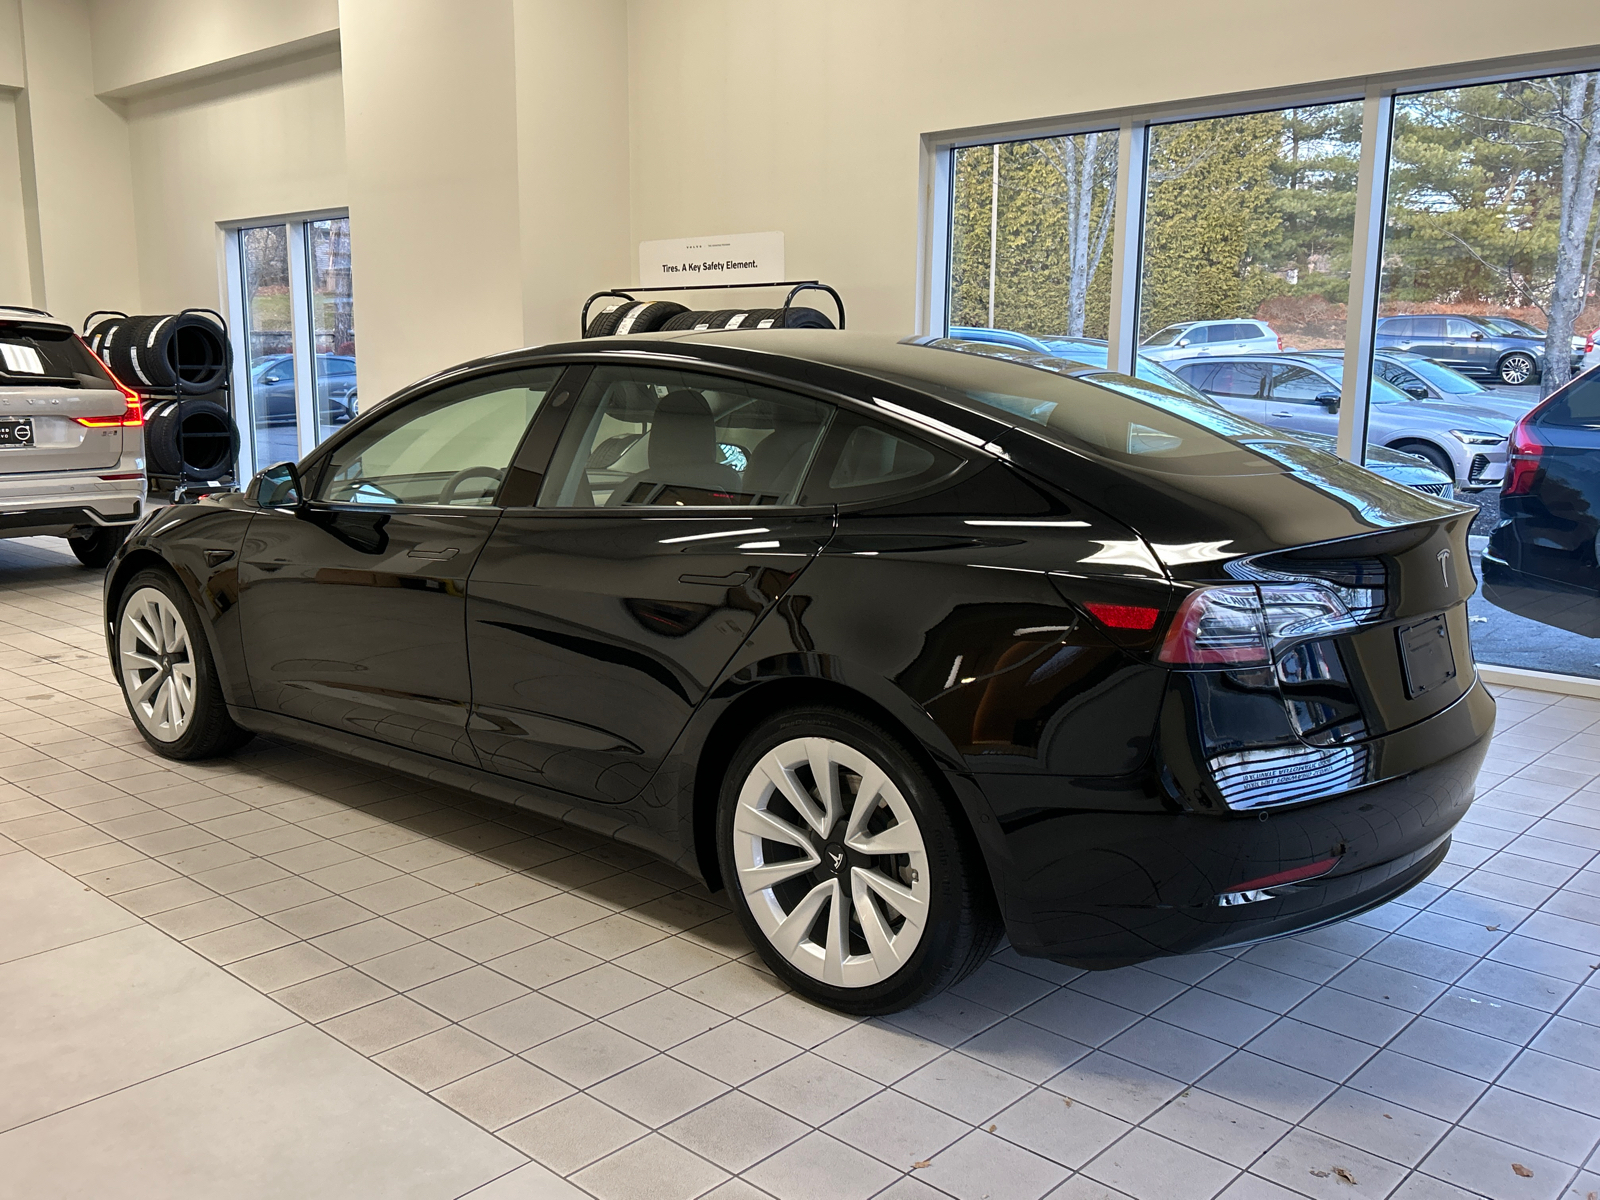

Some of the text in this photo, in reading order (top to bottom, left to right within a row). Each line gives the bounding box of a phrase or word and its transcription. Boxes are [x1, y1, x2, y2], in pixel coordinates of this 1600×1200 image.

[662, 259, 758, 273] Tires. A Key Safety Element.
